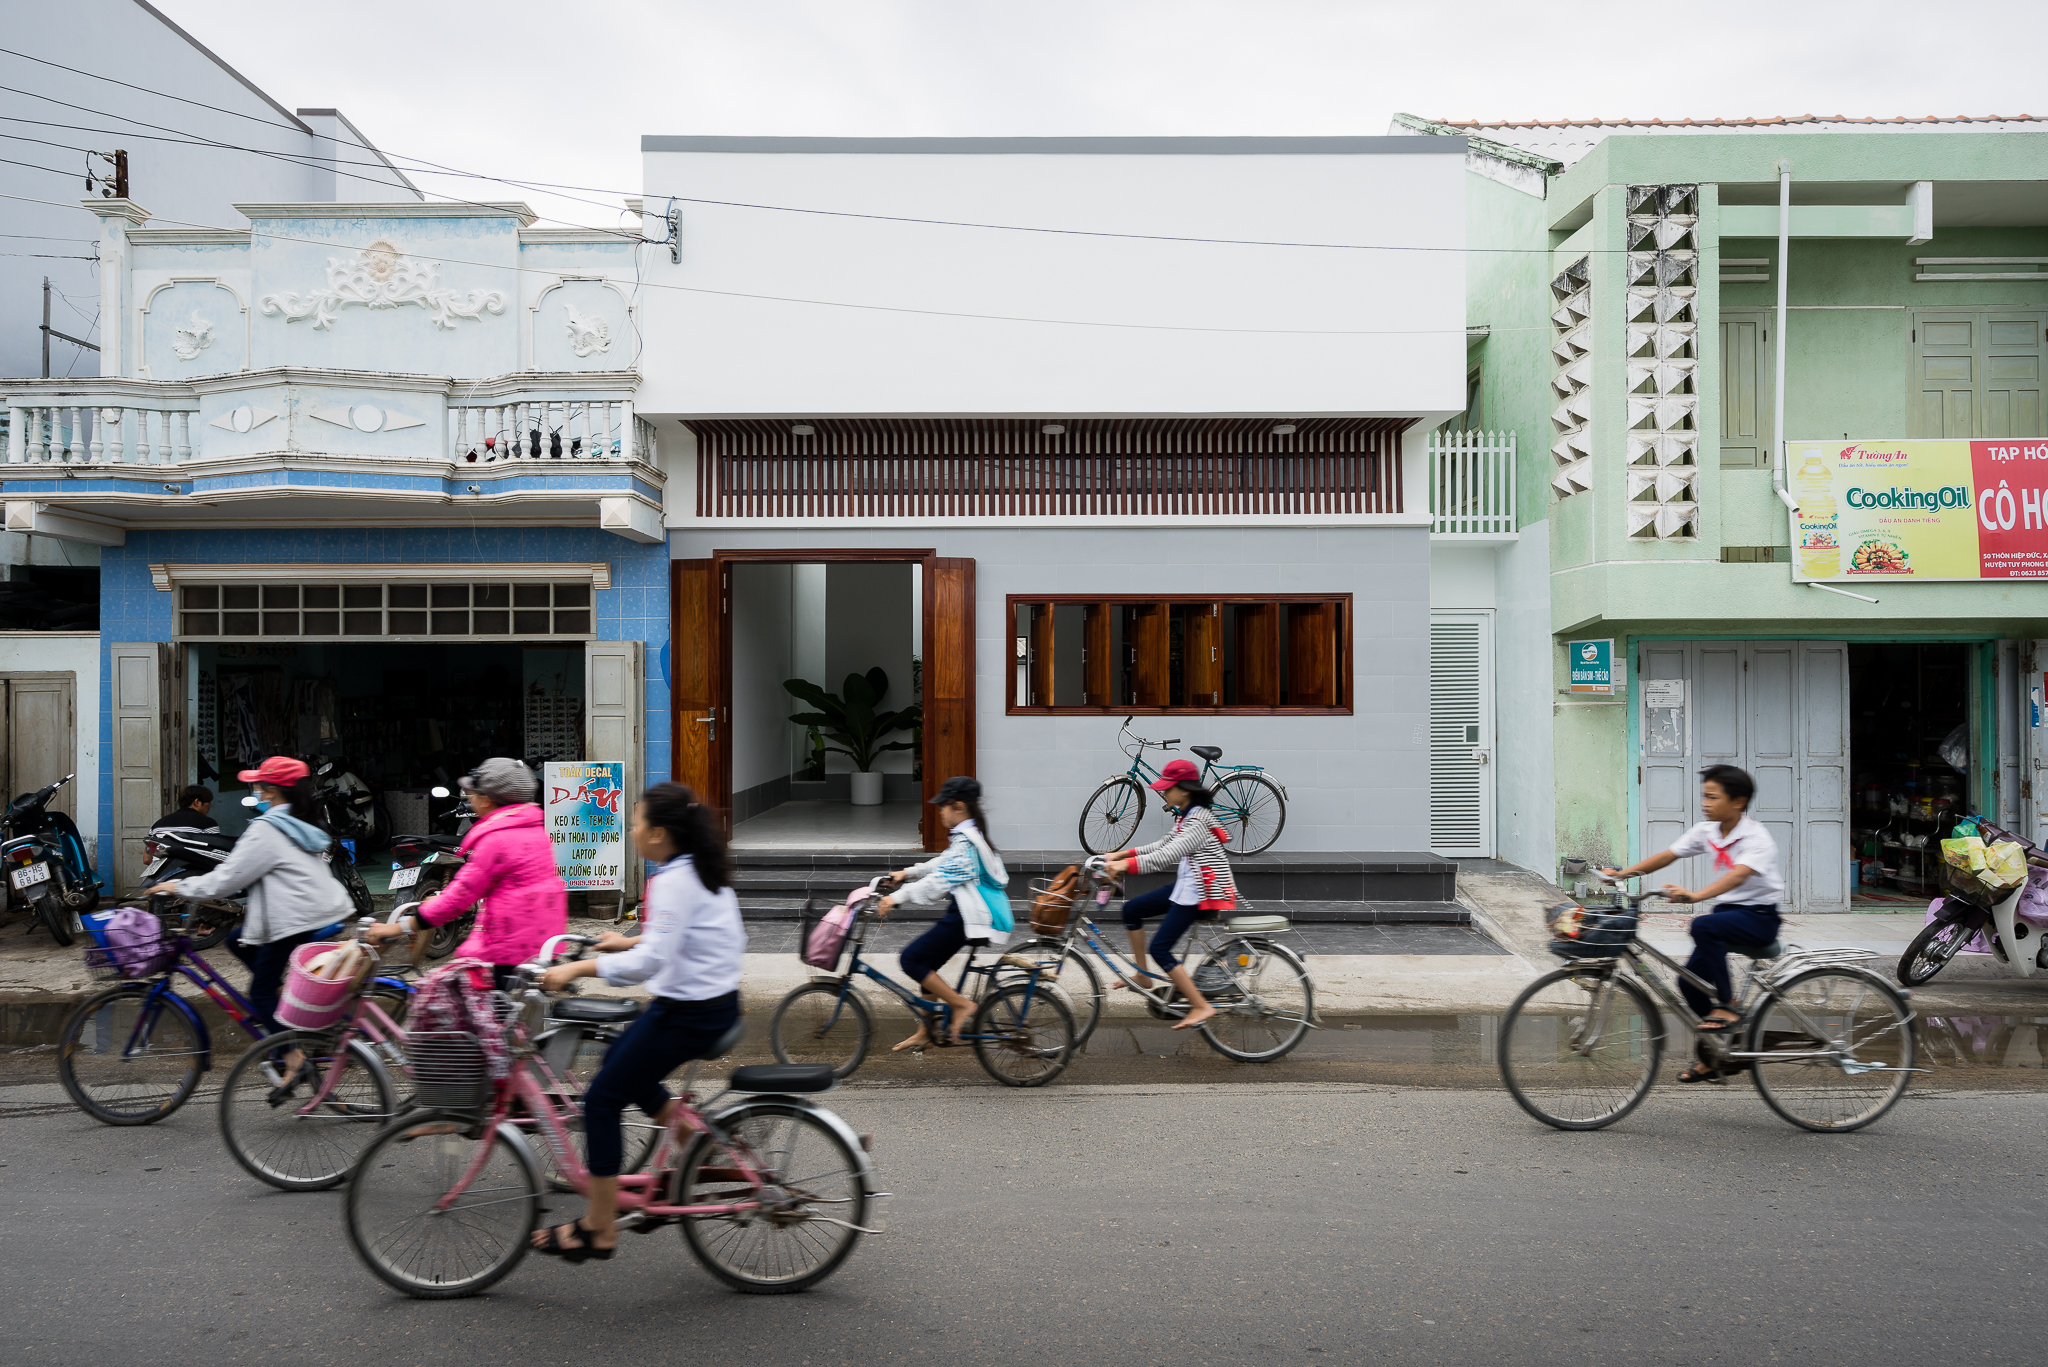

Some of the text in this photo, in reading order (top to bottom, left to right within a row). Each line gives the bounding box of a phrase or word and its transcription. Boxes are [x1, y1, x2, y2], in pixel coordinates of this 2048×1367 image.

[1988, 446, 2020, 464] TẠP
[1979, 480, 2048, 530] CÔ H
[2011, 552, 2025, 560] HIỆP
[559, 765, 612, 778] TOÀN DECAL
[555, 816, 568, 826] KEO
[571, 816, 580, 826] XE
[589, 816, 603, 826] TEM
[606, 816, 615, 826] XE
[550, 829, 620, 845] ĐIỆN THOẠI DI ĐỘNG
[572, 849, 597, 860] LAPTOP
[569, 863, 591, 876] CƯỜNG
[595, 864, 607, 878] LỰC
[610, 865, 618, 876] ĐT
[20, 872, 45, 886] 6843
